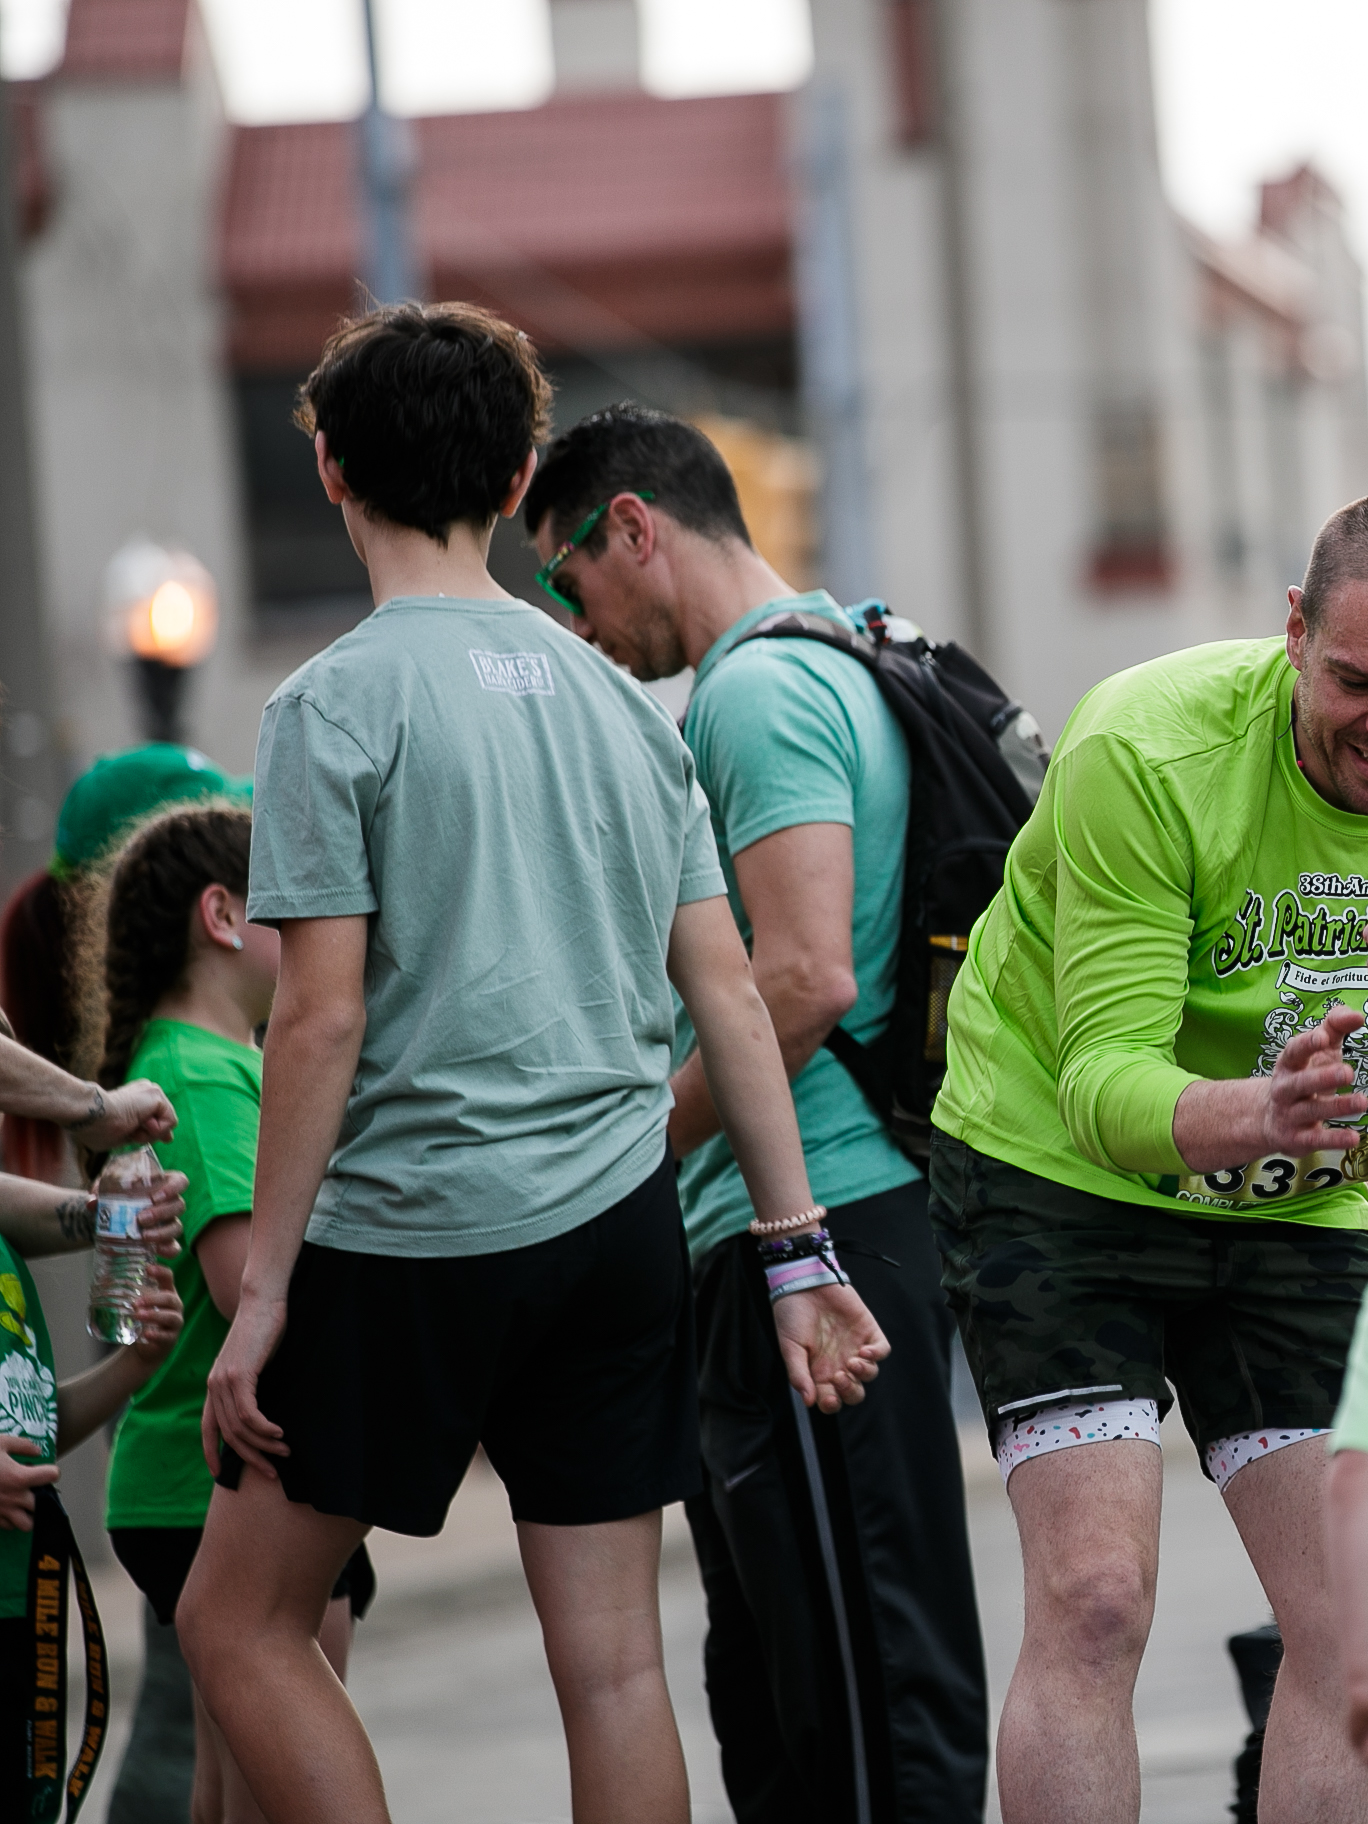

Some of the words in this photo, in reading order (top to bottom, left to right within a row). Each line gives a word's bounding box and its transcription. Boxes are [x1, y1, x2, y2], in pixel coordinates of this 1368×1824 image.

[478, 655, 542, 678] BLAKE'S
[1214, 889, 1265, 977] St.
[1294, 970, 1318, 985] Fide
[1320, 976, 1330, 986] et
[38, 1553, 61, 1572] 4
[35, 1577, 60, 1638] MILE
[35, 1641, 59, 1690] RUN
[87, 1640, 105, 1695] RUN
[34, 1718, 58, 1780] WALK
[68, 1724, 103, 1799] WALK
